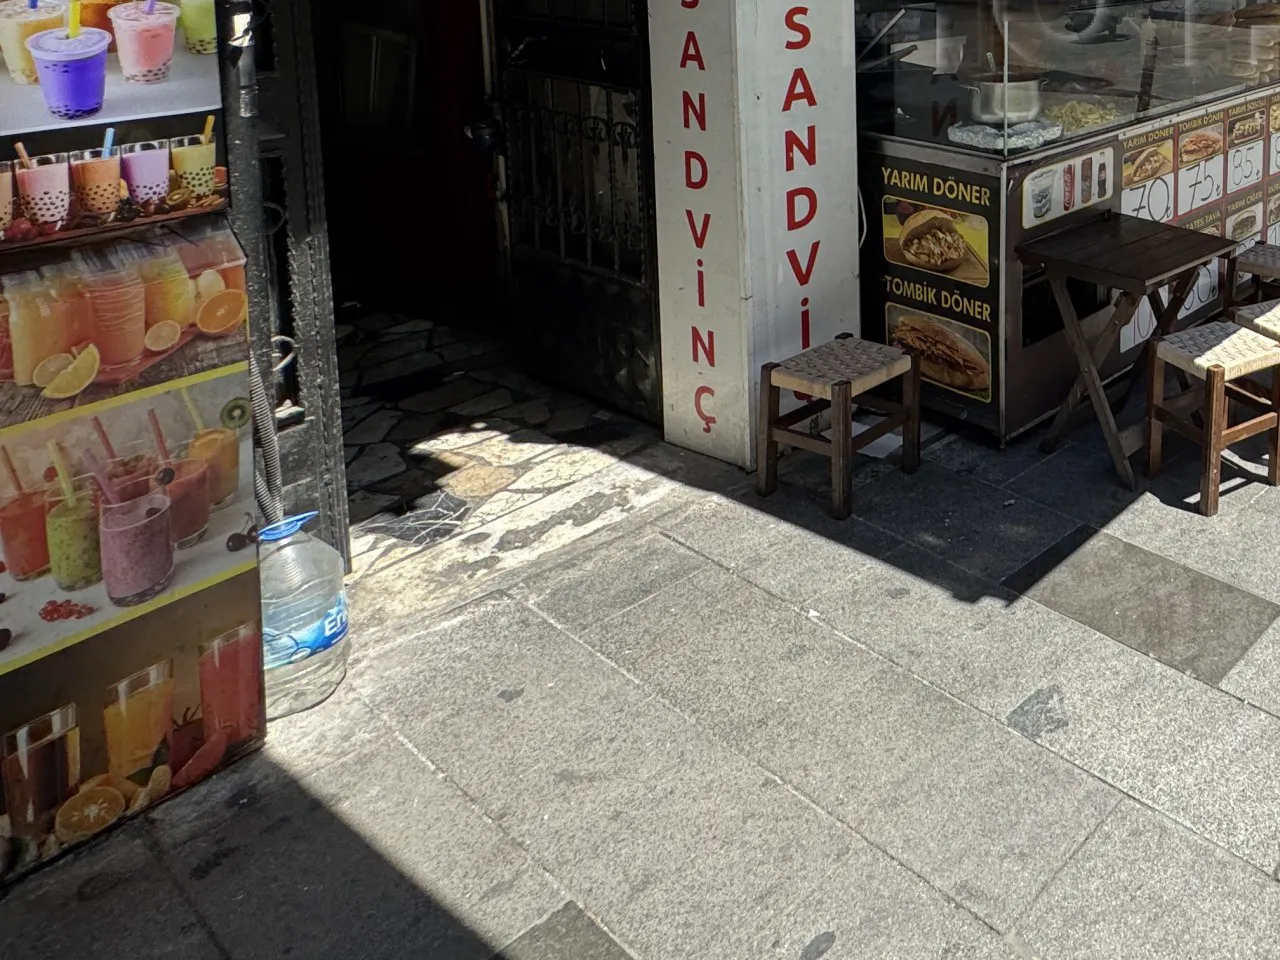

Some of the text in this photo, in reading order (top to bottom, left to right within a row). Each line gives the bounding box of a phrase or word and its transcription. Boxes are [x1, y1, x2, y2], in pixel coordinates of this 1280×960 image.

[1122, 126, 1174, 149] YARIM DÖNER
[1178, 111, 1224, 132] TOMBİK DÖNER
[882, 166, 991, 207] YARIM DÖNER
[782, 6, 821, 404] SANDVİ
[1204, 210, 1221, 224] TAVA
[884, 274, 991, 323] TOMBİK DÖNER
